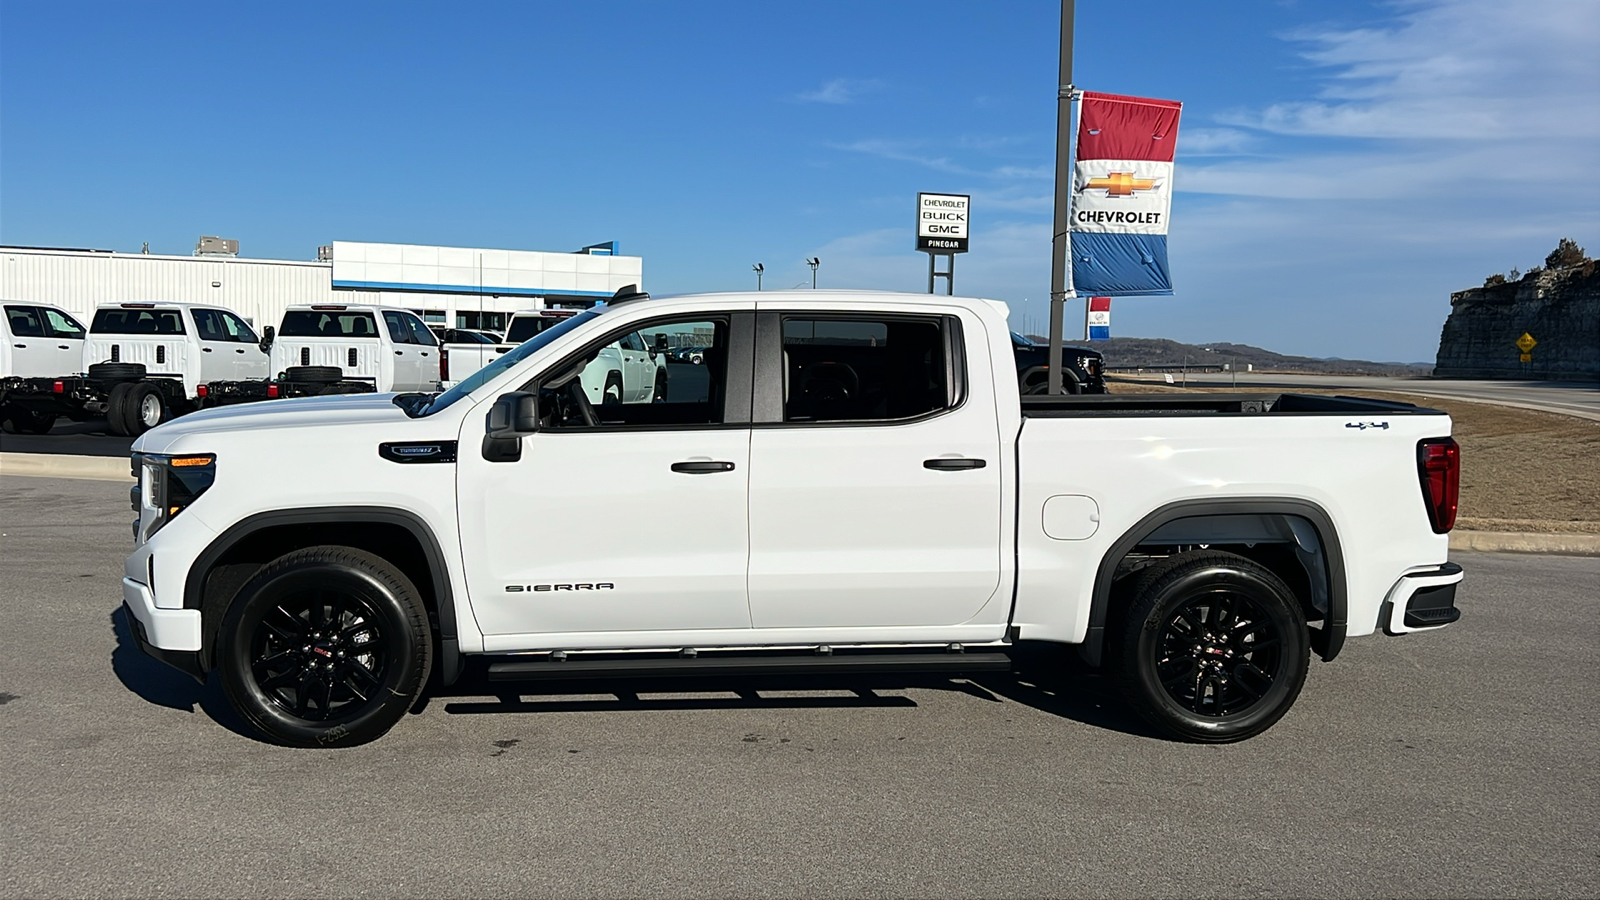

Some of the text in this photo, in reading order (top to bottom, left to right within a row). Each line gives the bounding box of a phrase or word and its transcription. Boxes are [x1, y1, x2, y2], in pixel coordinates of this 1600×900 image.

[924, 199, 966, 209] CHEVROLET
[922, 211, 966, 222] BUICK
[1077, 210, 1161, 224] CHEVROLET
[928, 224, 960, 234] GMC
[928, 239, 959, 249] PINEGAR
[505, 582, 614, 593] SIERRA
